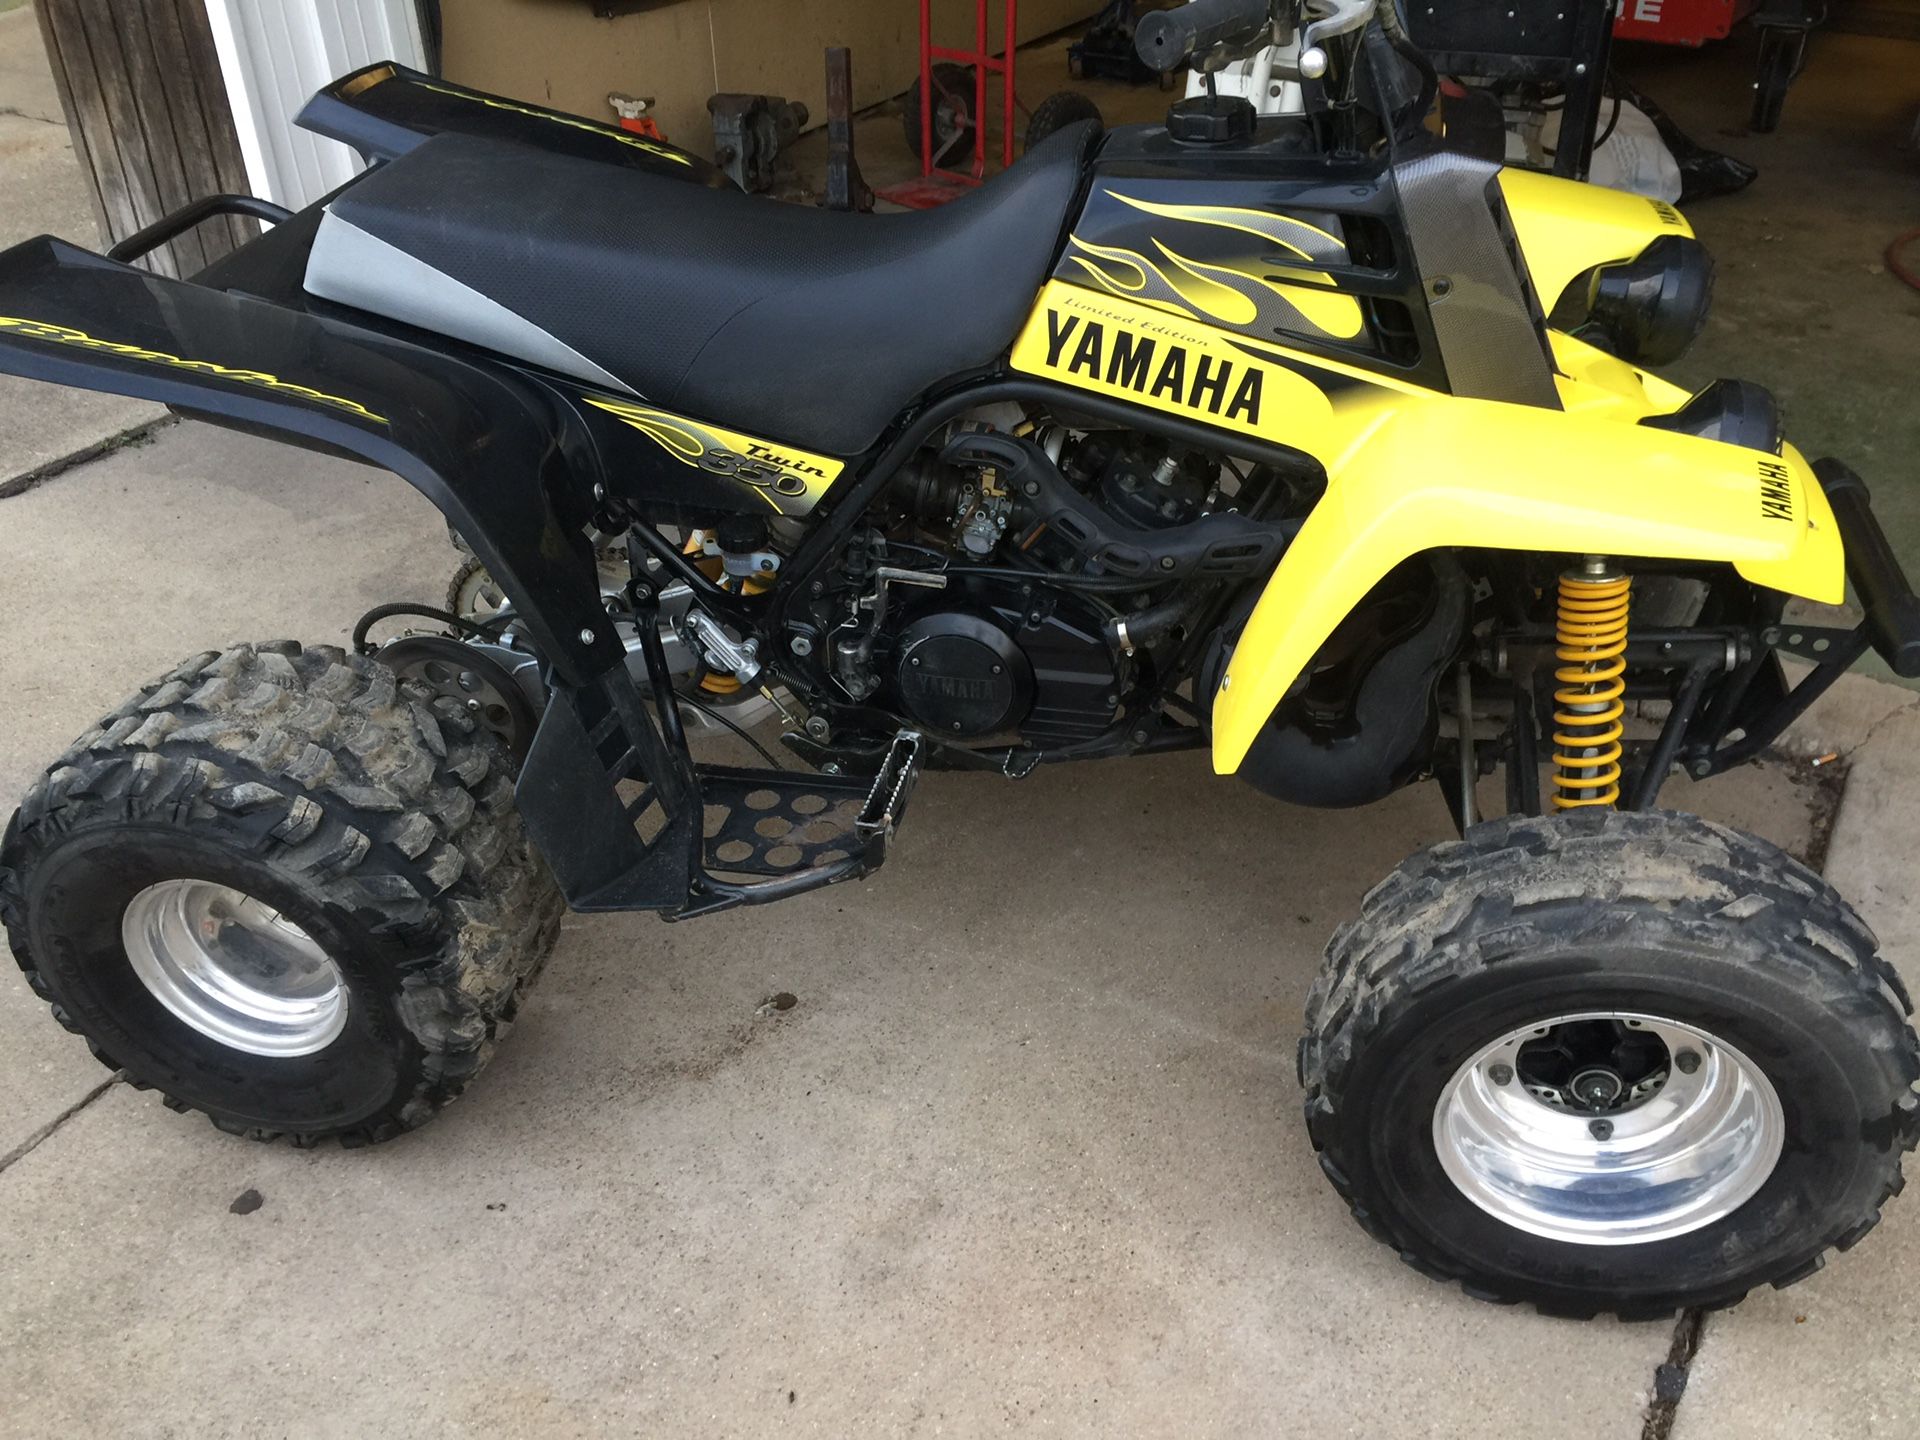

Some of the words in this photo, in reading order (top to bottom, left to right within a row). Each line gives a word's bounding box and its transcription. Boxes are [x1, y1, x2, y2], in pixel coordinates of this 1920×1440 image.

[1064, 298, 1136, 325] Limited
[1140, 321, 1208, 347] Edition
[1045, 309, 1264, 426] YAMAHA
[697, 447, 807, 497] 350
[746, 443, 827, 478] Twin
[1757, 461, 1793, 522] YAMAHA
[918, 673, 999, 700] YAMAHA
